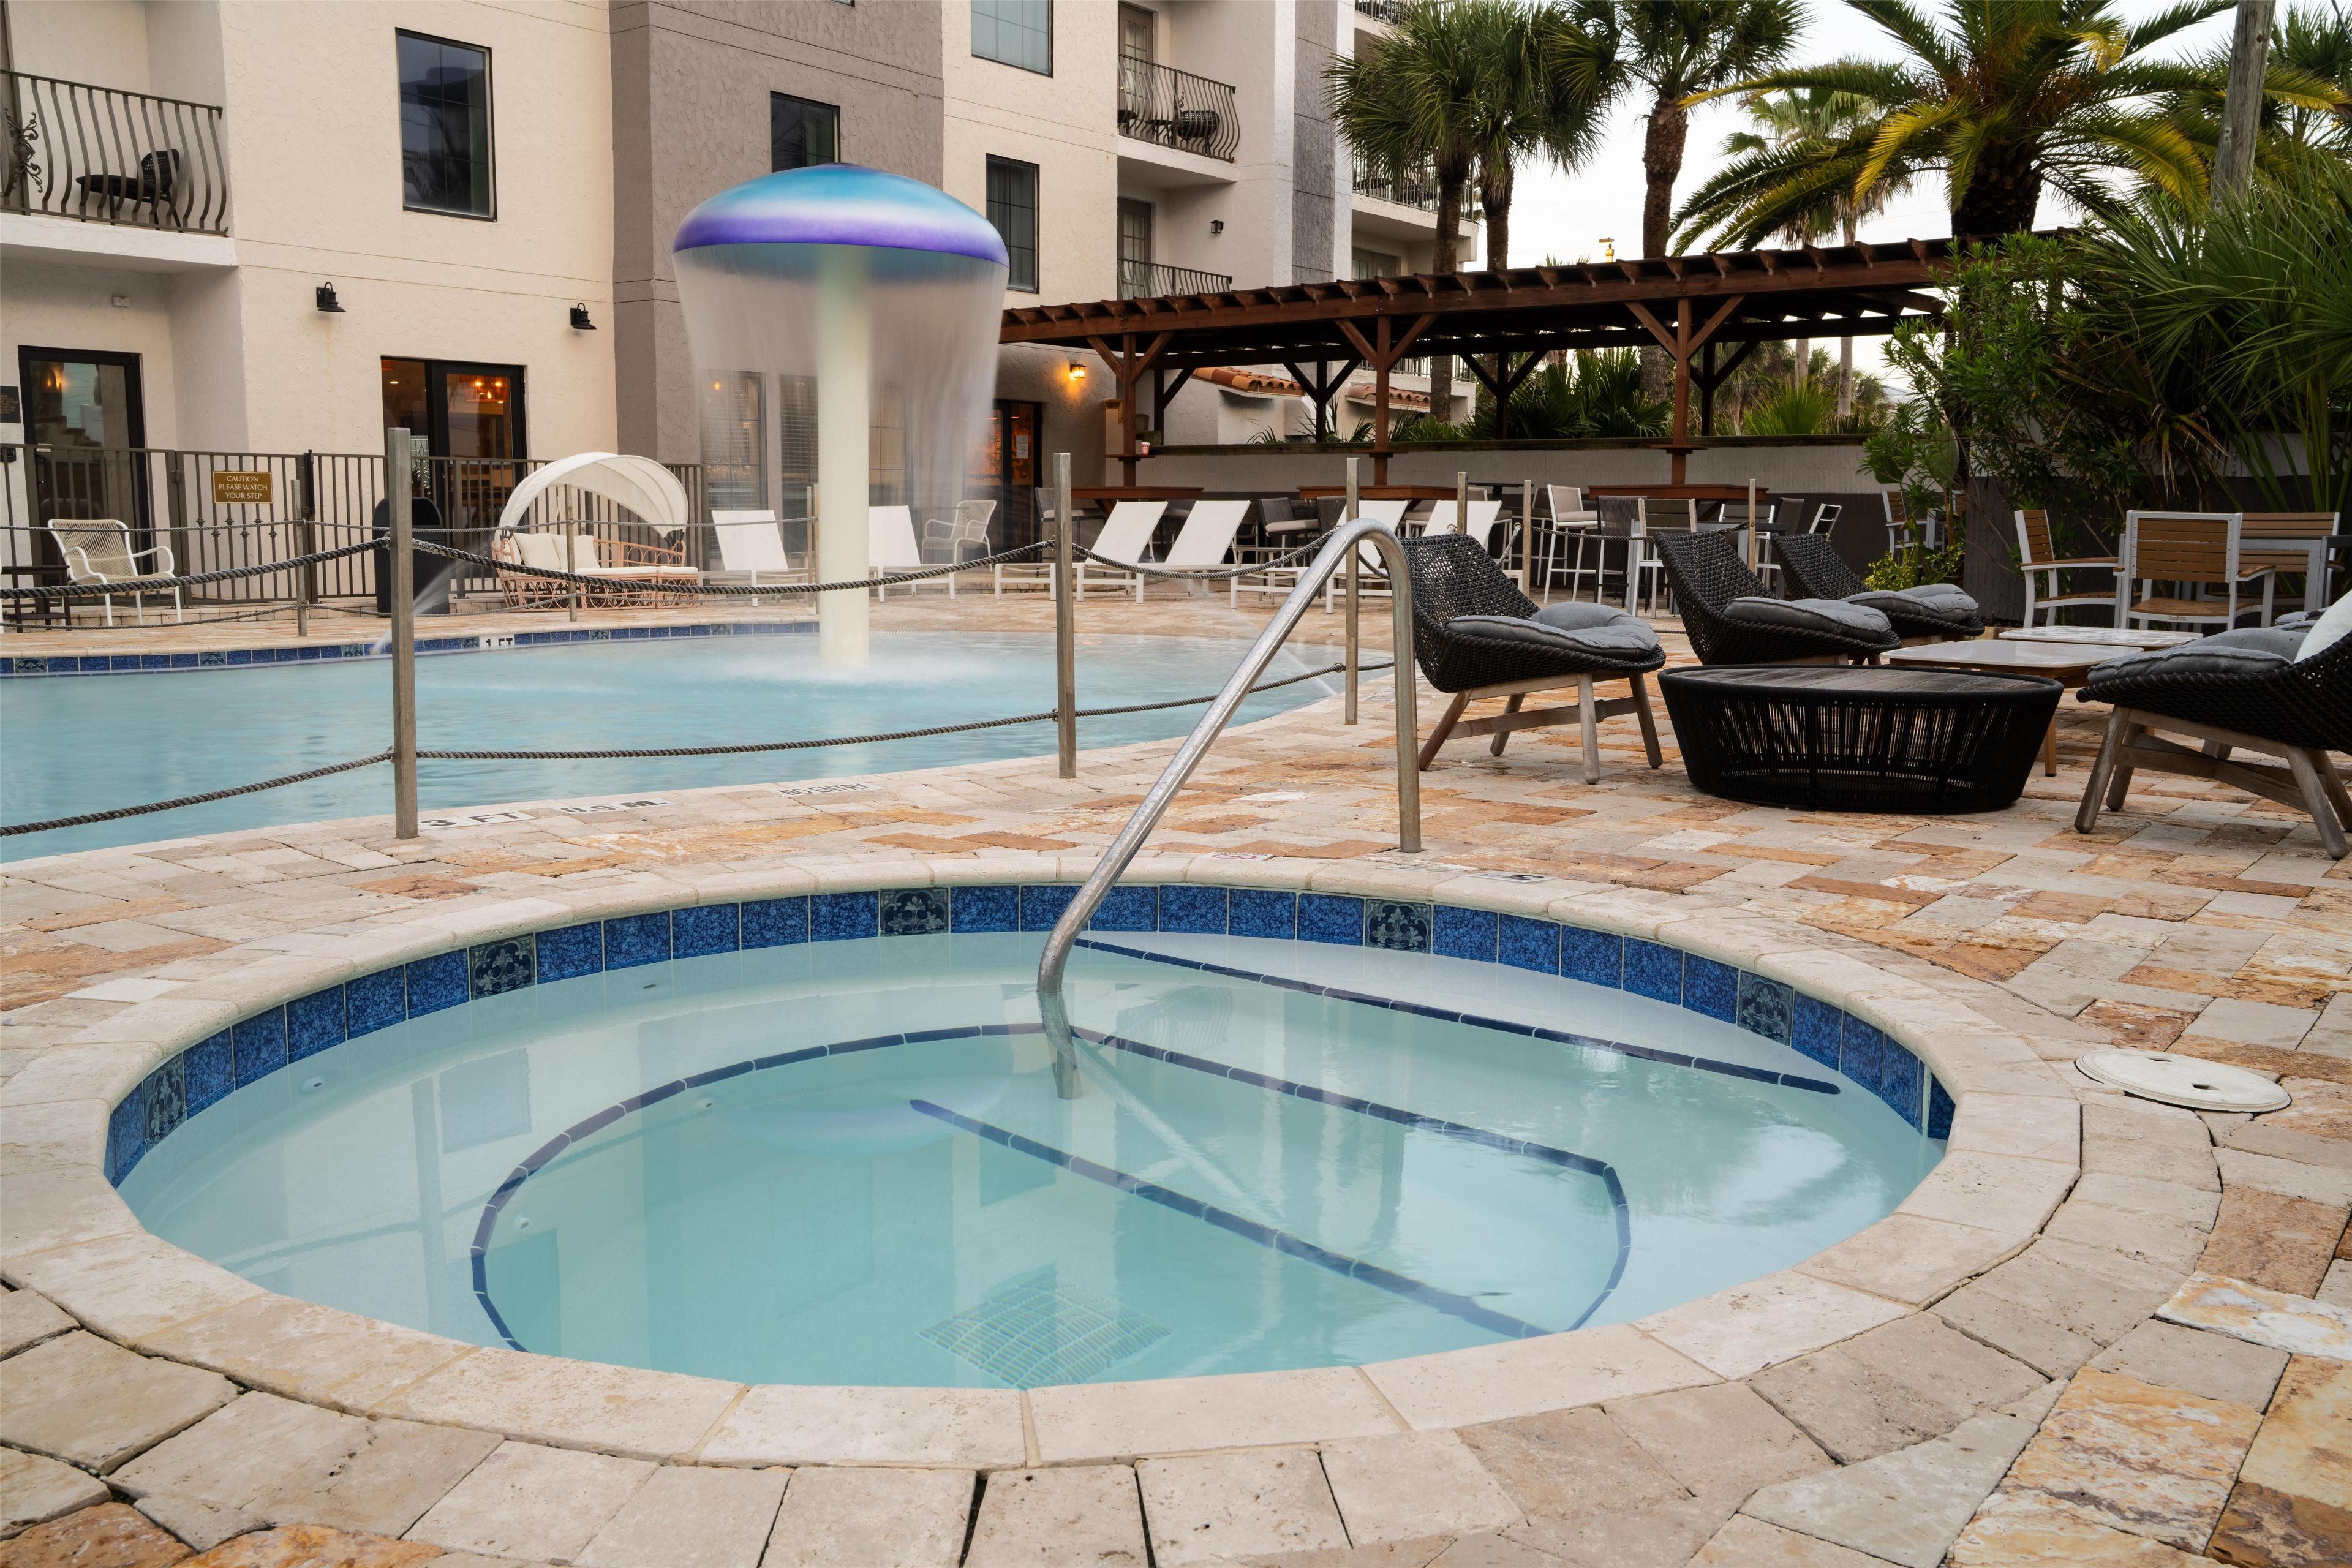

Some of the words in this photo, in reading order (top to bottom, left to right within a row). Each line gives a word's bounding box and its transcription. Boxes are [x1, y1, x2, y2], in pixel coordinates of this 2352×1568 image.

[486, 638, 491, 647] 1
[809, 783, 871, 793] ENTRY
[468, 812, 521, 823] FT
